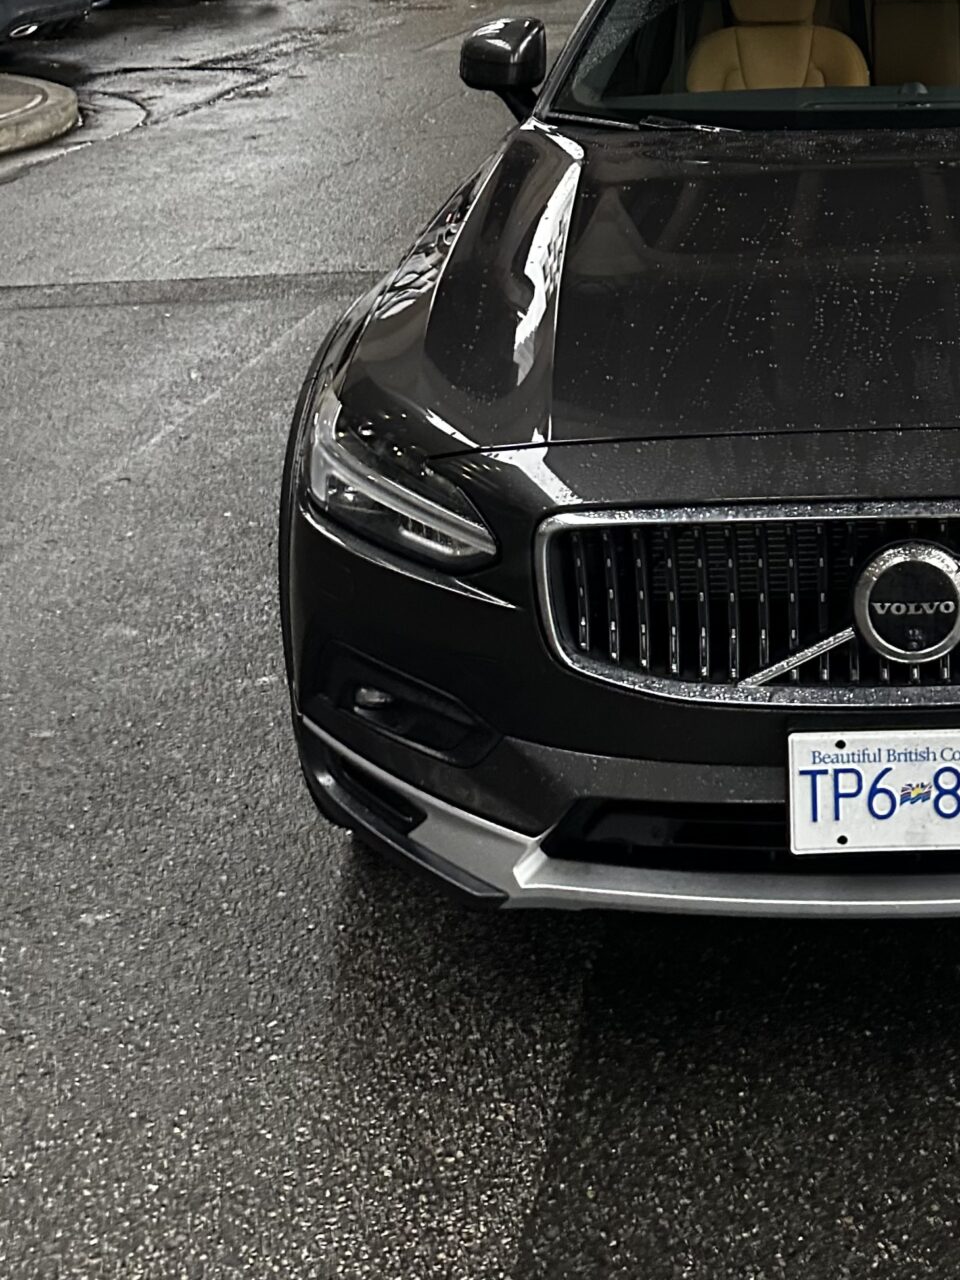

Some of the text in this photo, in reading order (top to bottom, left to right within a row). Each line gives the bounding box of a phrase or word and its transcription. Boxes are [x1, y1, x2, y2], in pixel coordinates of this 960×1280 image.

[871, 601, 955, 615] VOLVO
[812, 748, 882, 765] Beautiful
[886, 747, 937, 763] British
[799, 767, 897, 823] TP6
